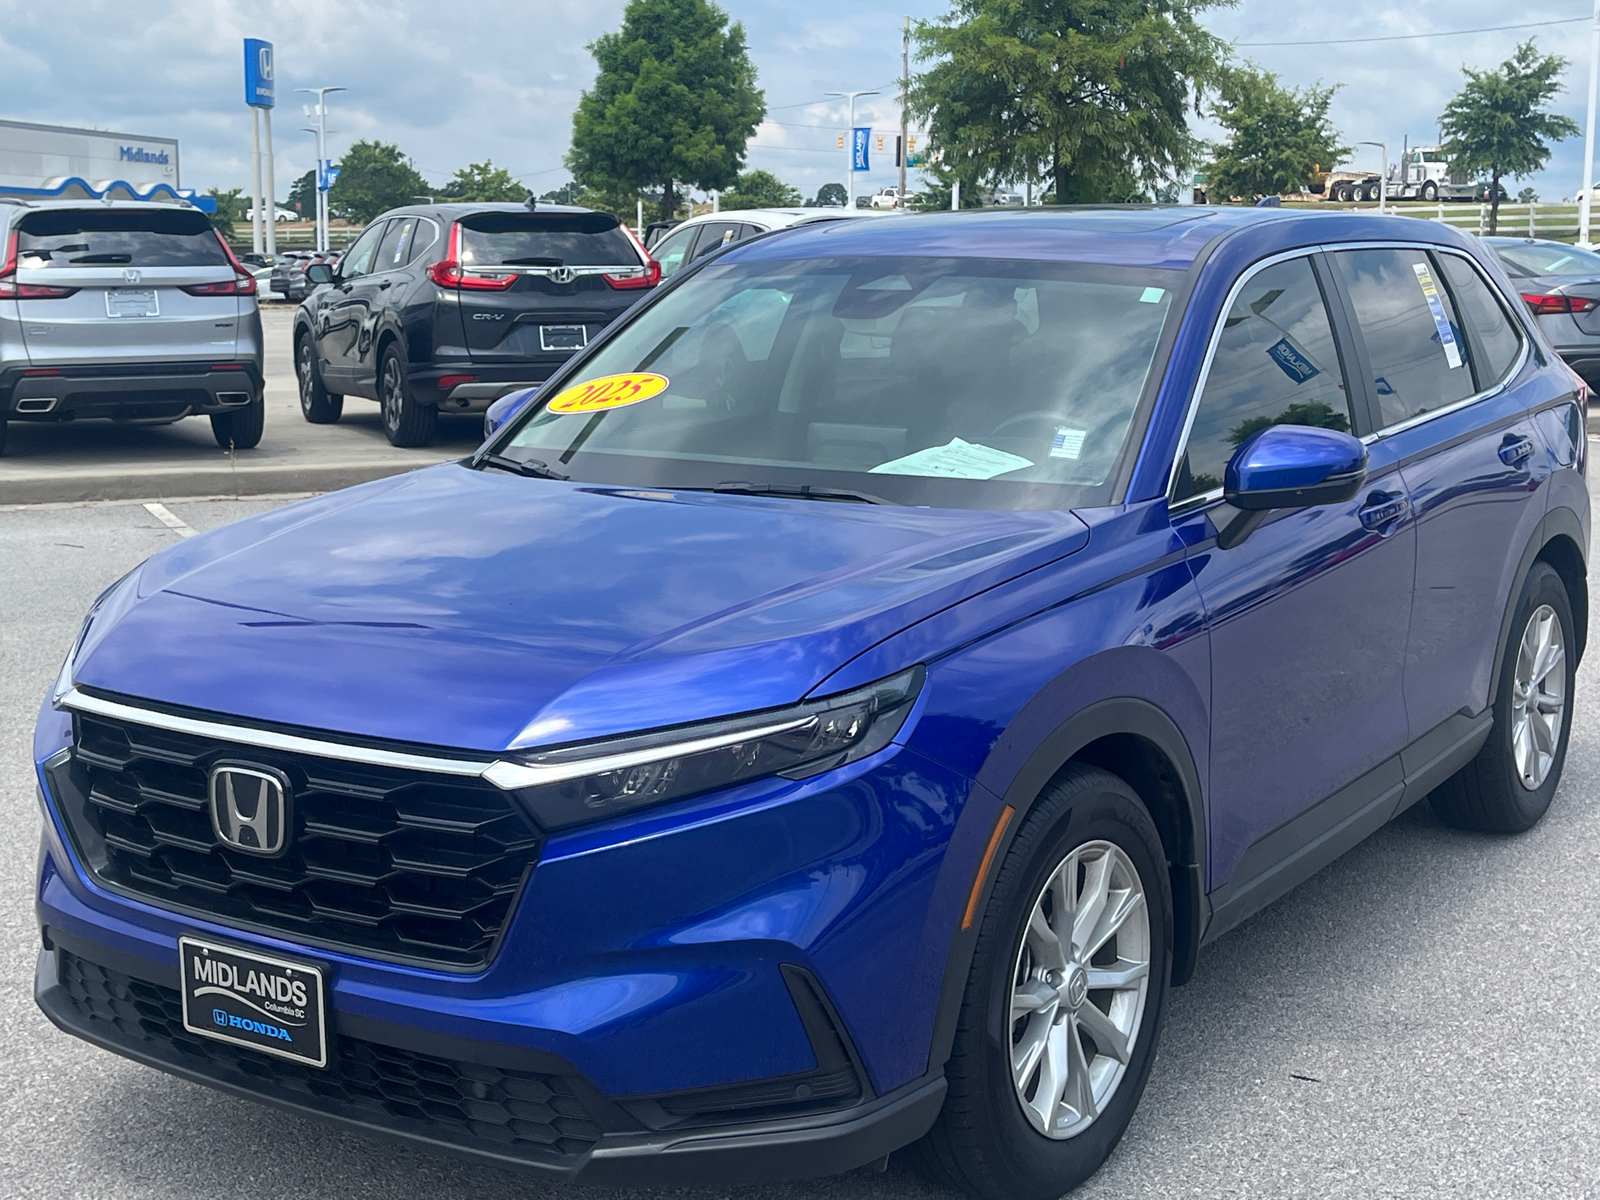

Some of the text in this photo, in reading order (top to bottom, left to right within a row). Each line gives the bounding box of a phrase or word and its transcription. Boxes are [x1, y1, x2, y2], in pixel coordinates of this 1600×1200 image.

[120, 146, 169, 165] Midlands
[558, 377, 655, 409] 2025
[193, 956, 308, 1007] MIDLANDS
[264, 1001, 305, 1019] Columbia SC
[228, 1014, 293, 1042] HONDA
